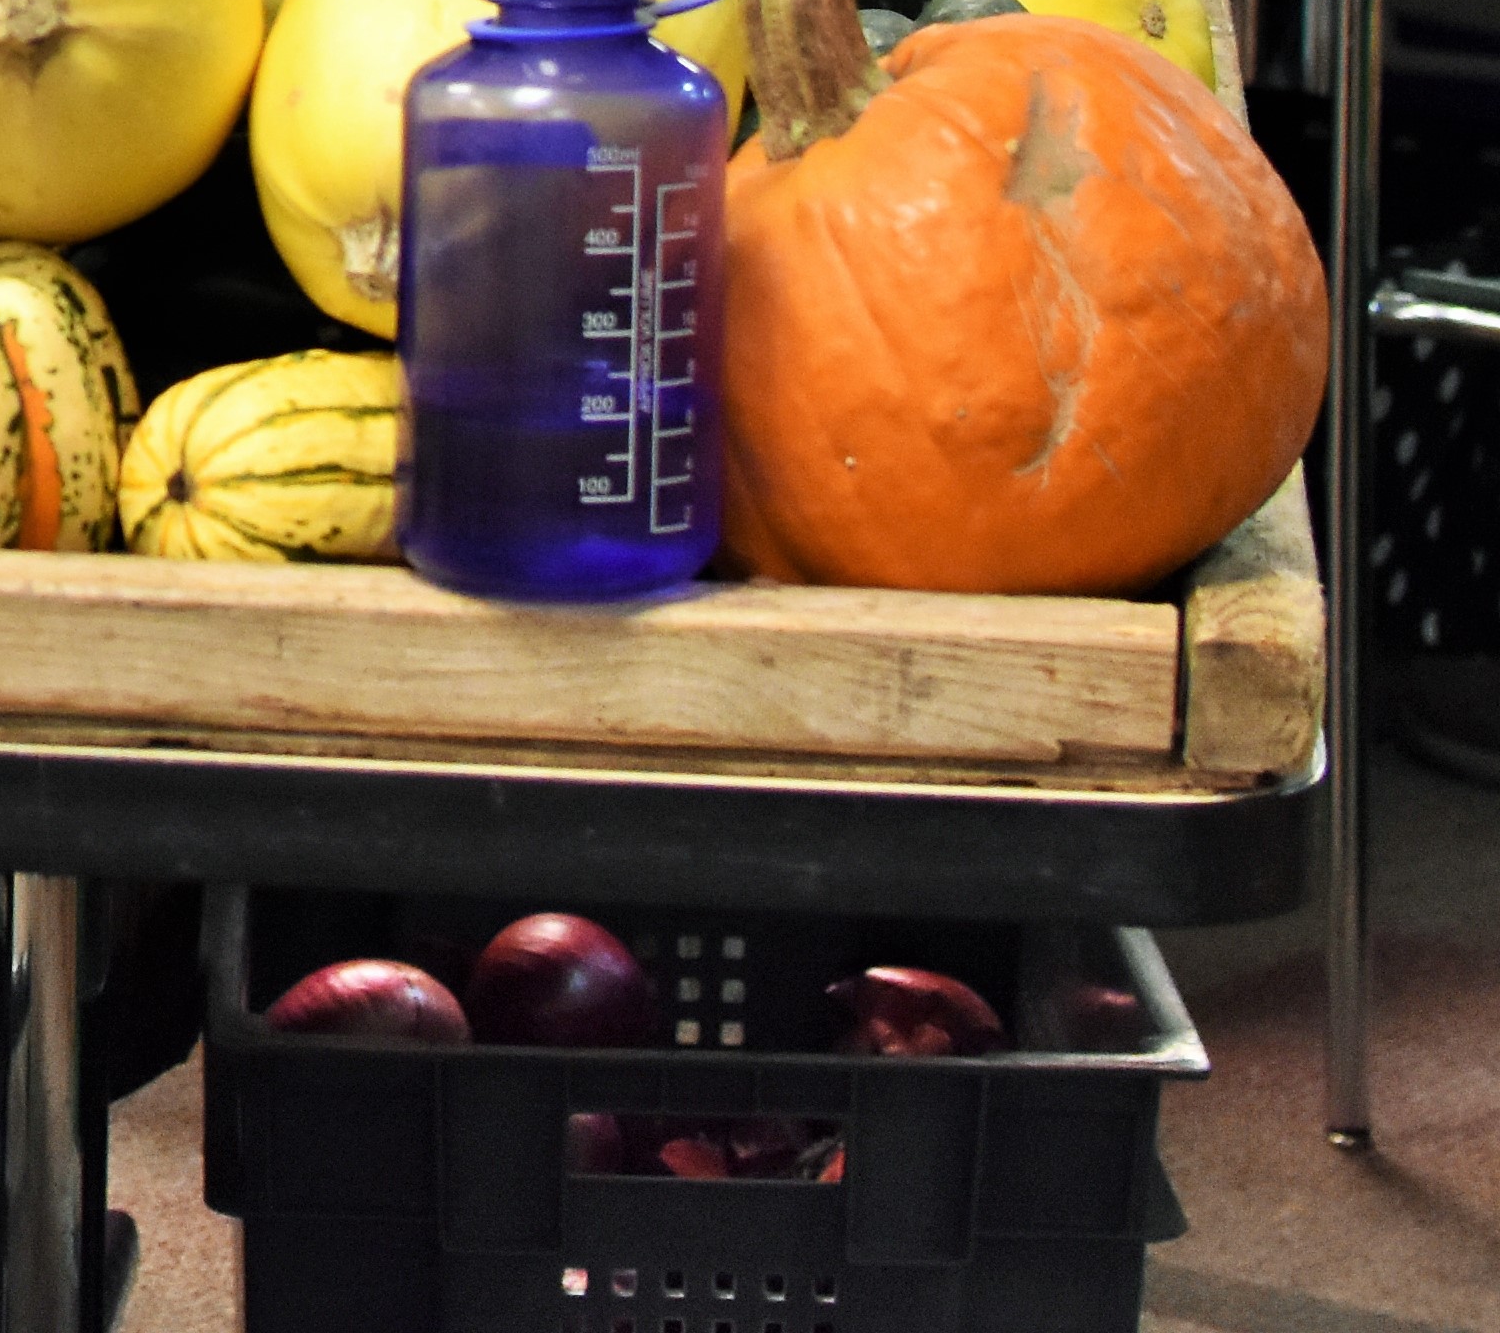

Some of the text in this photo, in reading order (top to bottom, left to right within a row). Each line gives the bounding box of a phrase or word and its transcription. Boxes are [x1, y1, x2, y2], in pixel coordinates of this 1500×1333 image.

[584, 228, 620, 246] 400
[581, 311, 618, 330] 300
[581, 395, 616, 413] 200
[579, 476, 611, 495] 100
